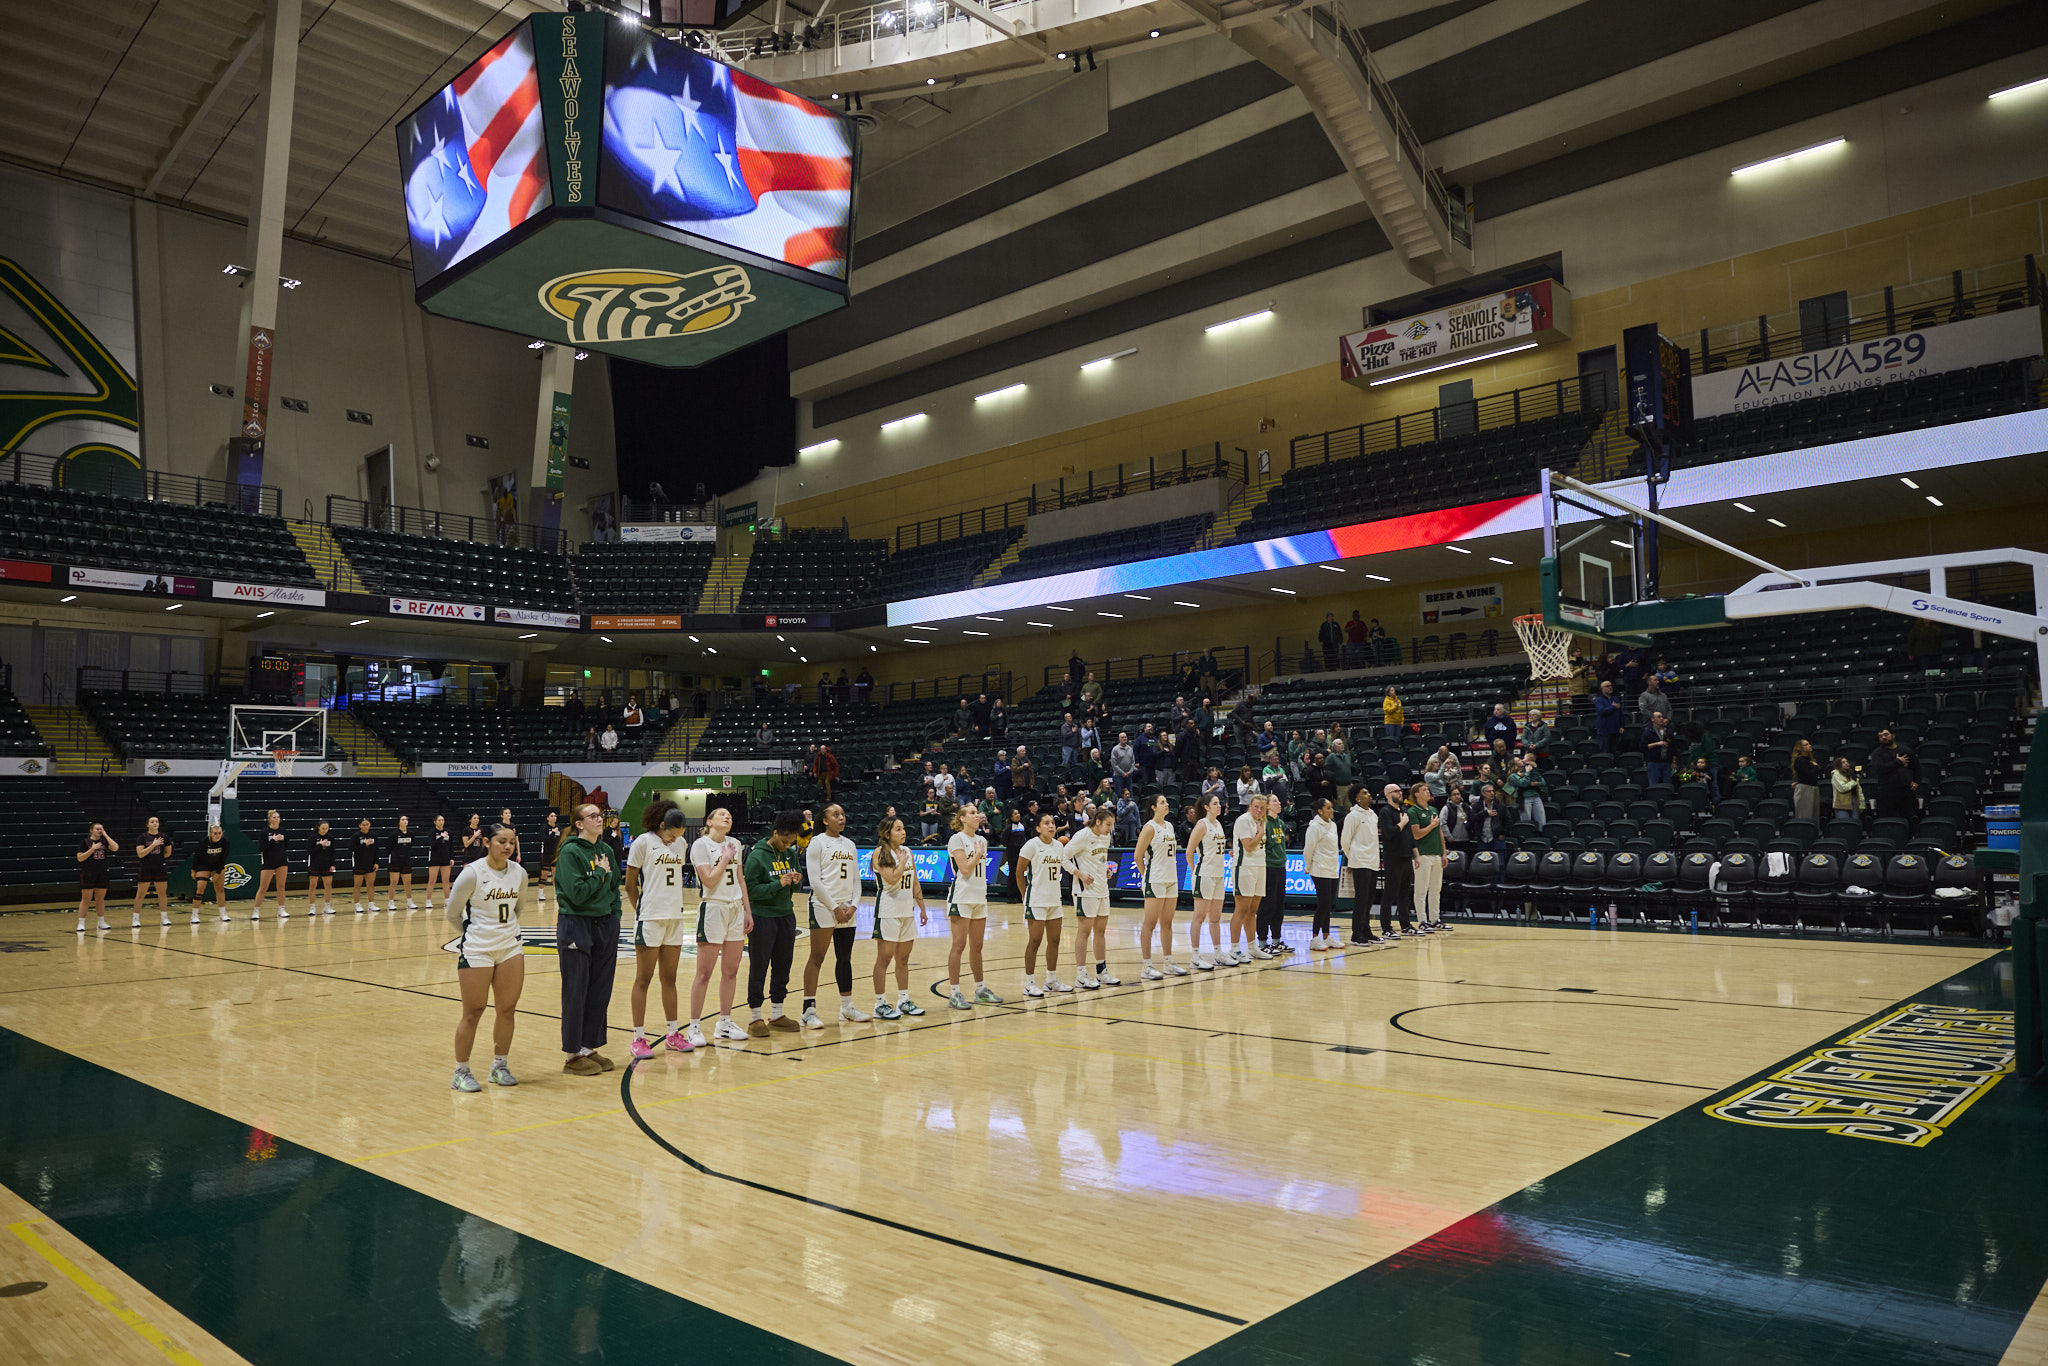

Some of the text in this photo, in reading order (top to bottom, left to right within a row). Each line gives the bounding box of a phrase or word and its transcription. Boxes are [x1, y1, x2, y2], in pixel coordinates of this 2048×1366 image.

[560, 15, 581, 202] SEAWOLVES
[1449, 306, 1497, 333] SEAWOLF
[1450, 321, 1505, 349] ATHLETICS
[1361, 341, 1395, 360] Pizza
[1400, 344, 1437, 361] THE HUT
[1362, 355, 1389, 370] Hut
[1734, 367, 1927, 411] EDUCATION SAVINGS PLAN
[234, 586, 304, 601] AVIS Alaska
[1426, 586, 1496, 602] BEER & WINE
[408, 601, 465, 617] RE/MAX
[515, 610, 562, 624] Alaska Chips
[1970, 612, 2002, 625] Sports
[261, 659, 290, 671] 10:00
[683, 764, 731, 774] Providence
[926, 851, 938, 865] 49
[666, 868, 674, 886] 2
[725, 869, 734, 885] 3
[840, 862, 847, 879] 5
[974, 862, 982, 878] 11
[1048, 866, 1057, 881] 12
[900, 874, 911, 890] 10
[484, 887, 518, 901] Alaska
[499, 903, 509, 923] 0
